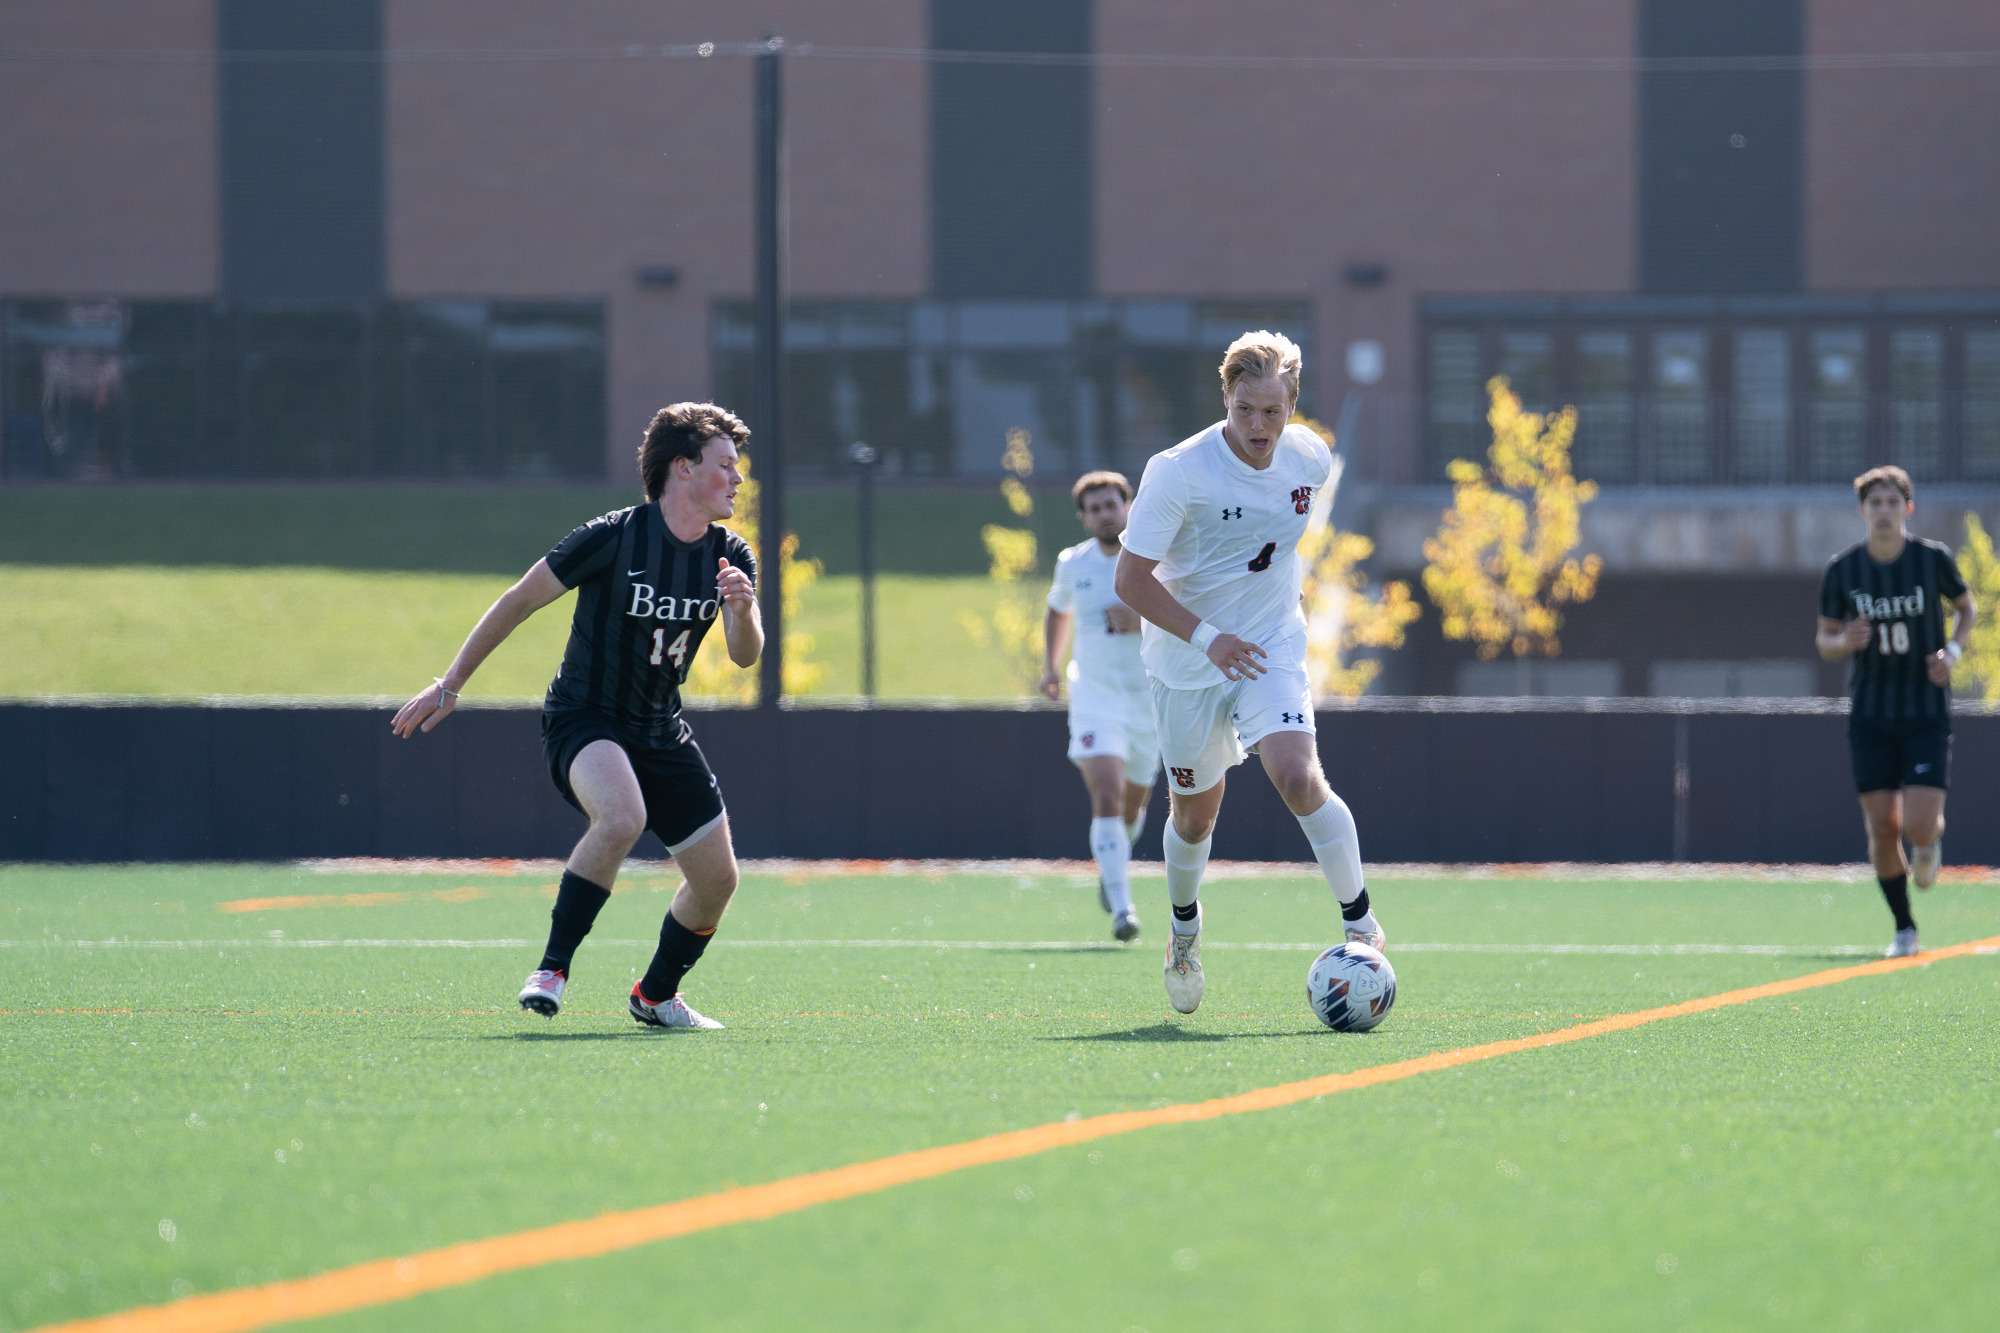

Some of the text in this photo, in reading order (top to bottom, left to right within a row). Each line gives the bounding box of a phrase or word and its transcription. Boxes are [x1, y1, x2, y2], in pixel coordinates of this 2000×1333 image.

[1248, 542, 1276, 572] 4
[626, 583, 722, 620] Bard
[1855, 585, 1924, 620] Bard
[650, 628, 691, 668] 14
